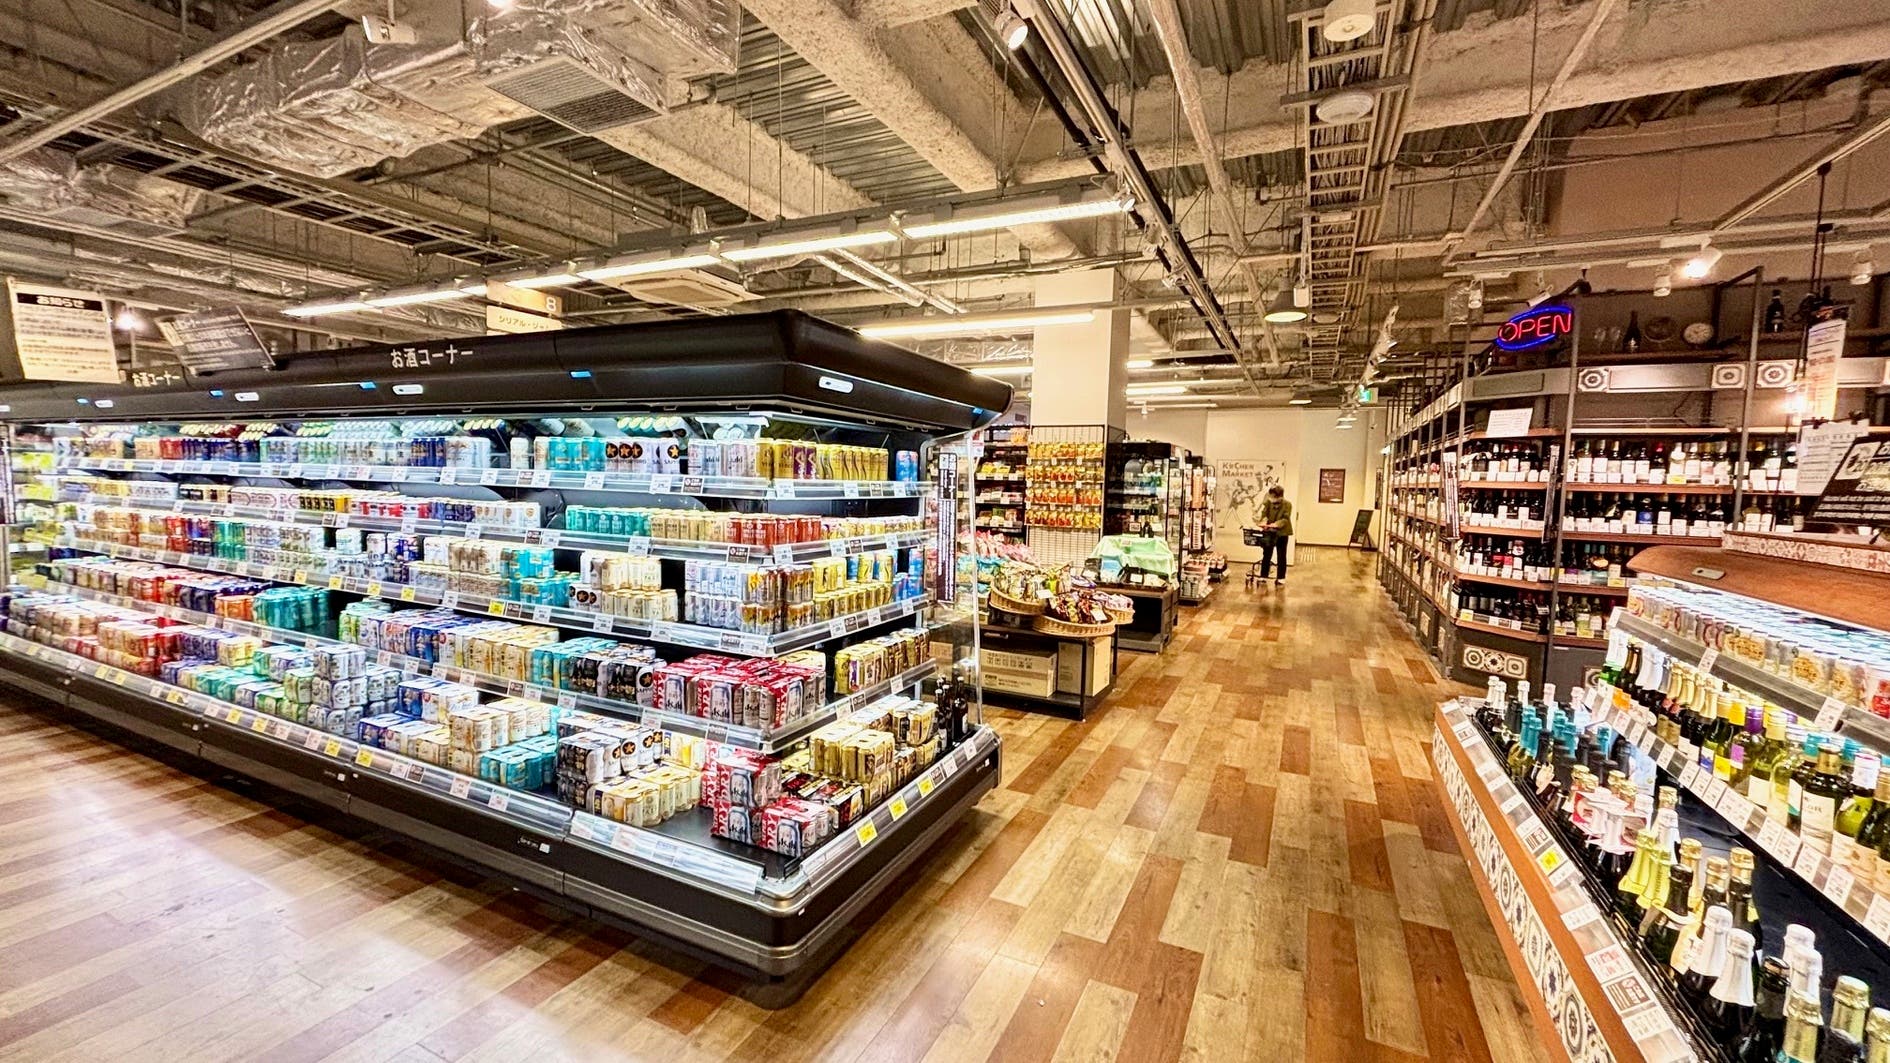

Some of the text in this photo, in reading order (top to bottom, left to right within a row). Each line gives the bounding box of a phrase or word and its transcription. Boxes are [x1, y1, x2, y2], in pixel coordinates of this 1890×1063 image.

[545, 296, 557, 312] 8
[1498, 313, 1573, 343] OPEN
[390, 344, 474, 370] お酒コーナー
[131, 369, 181, 388] お酒コーナー
